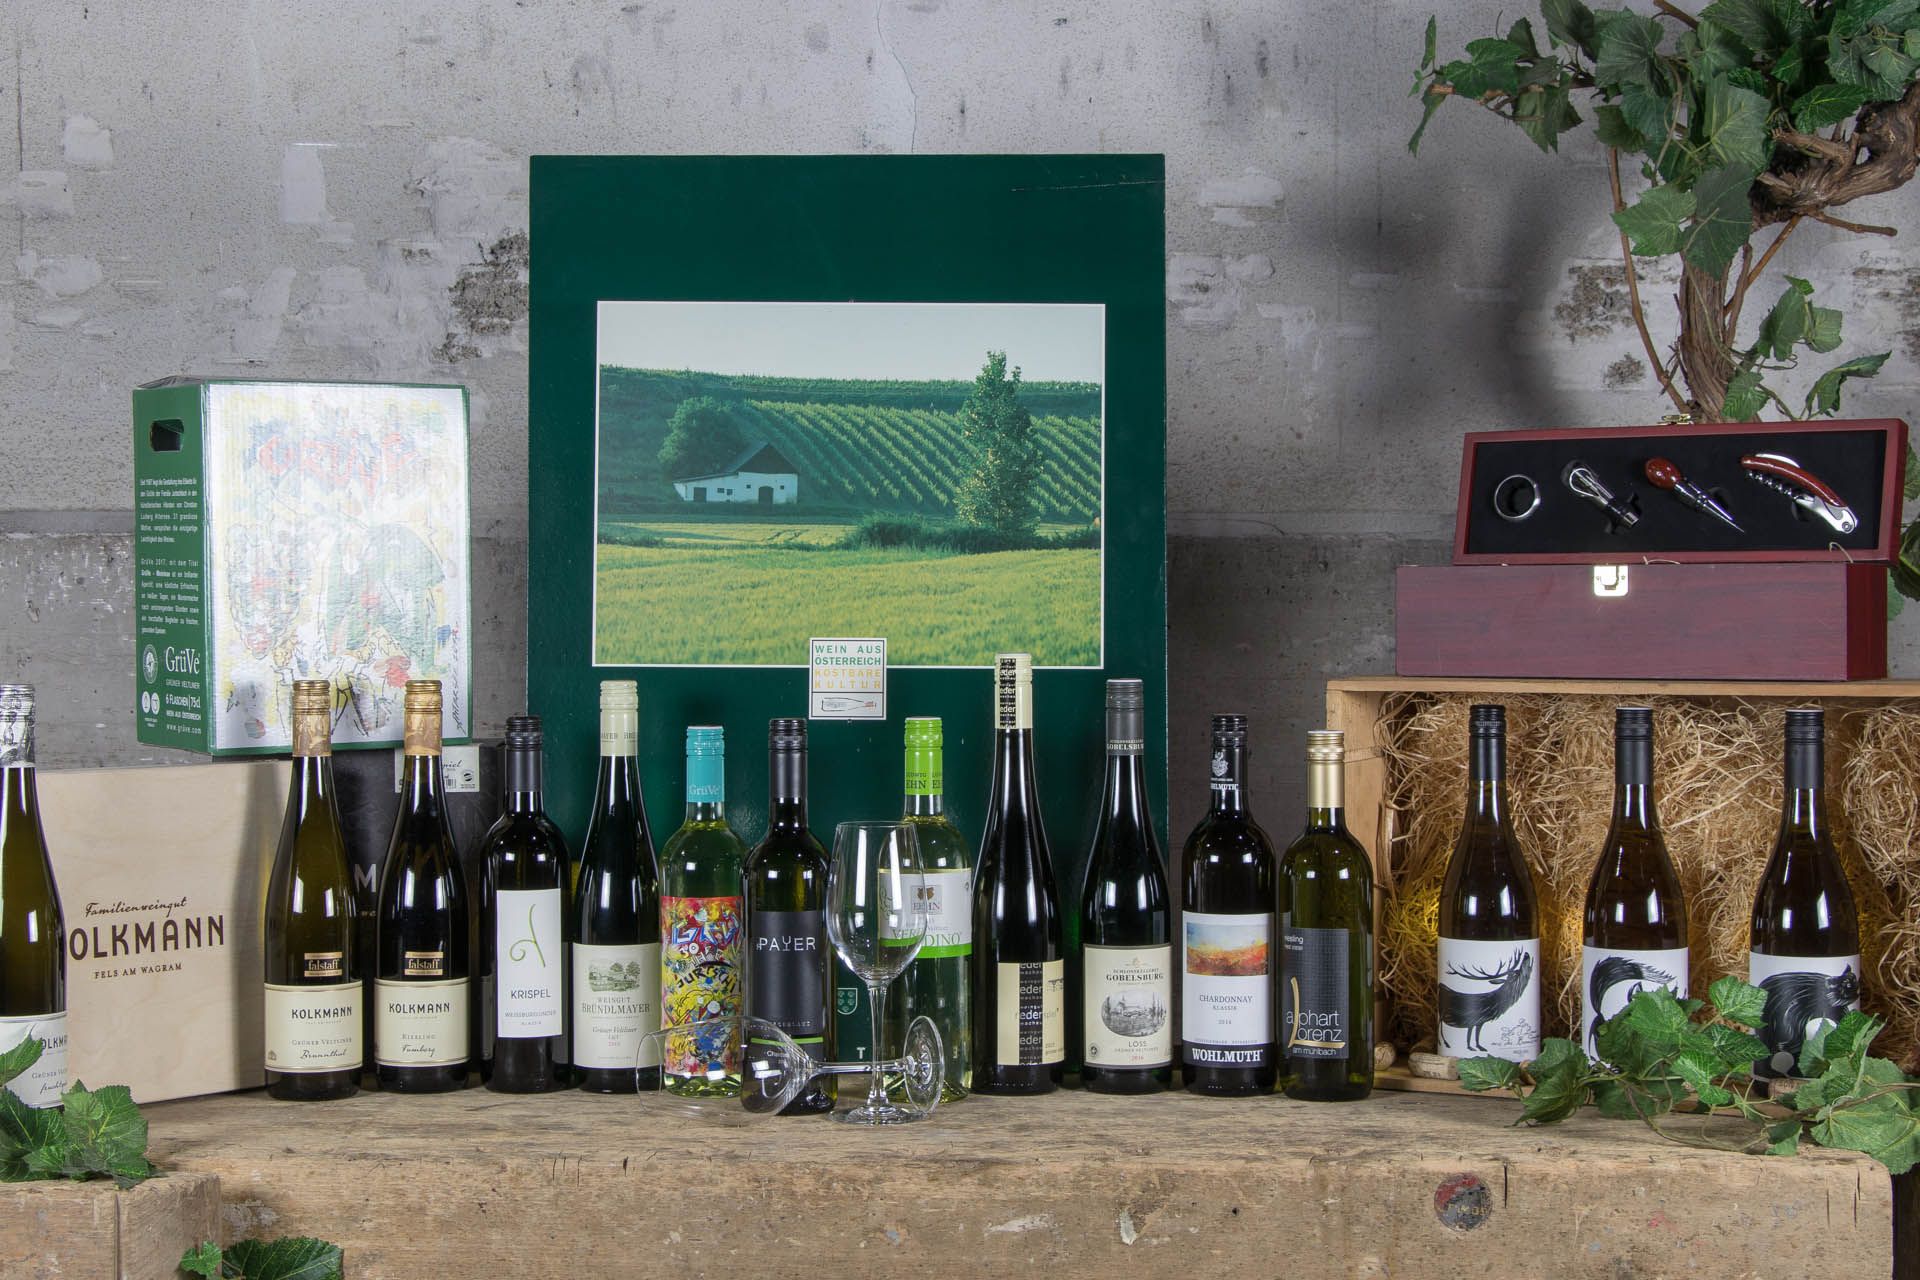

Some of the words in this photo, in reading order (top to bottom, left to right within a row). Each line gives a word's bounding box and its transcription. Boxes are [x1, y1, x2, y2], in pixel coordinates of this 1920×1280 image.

[815, 645, 847, 654] WEIN
[857, 645, 881, 654] AUS
[165, 646, 200, 674] GrüVe
[814, 654, 881, 666] ÖSTERREICH
[814, 669, 881, 678] KOSTBARE
[814, 680, 881, 689] KULTUR
[1000, 686, 1016, 695] eder
[1000, 704, 1016, 713] eder
[85, 897, 188, 918] Familienweingut
[69, 914, 225, 961] OLKMANN
[759, 936, 816, 951] PAYER
[308, 958, 340, 970] falstaff
[408, 958, 440, 969] falstaff
[94, 969, 119, 979] FELS
[122, 967, 137, 977] AM
[140, 962, 183, 975] WAGRAM
[1106, 972, 1164, 982] GOBELSBURG
[510, 988, 551, 1000] KRISPEL
[1019, 985, 1042, 994] eder
[1199, 994, 1253, 1004] CHARDONNAY
[291, 1006, 353, 1020] KOLKMANN
[389, 1002, 450, 1014] KOLKMANN
[1019, 1010, 1042, 1020] eder
[1019, 1036, 1042, 1045] eder
[1191, 1048, 1261, 1063] WOHLMUTH
